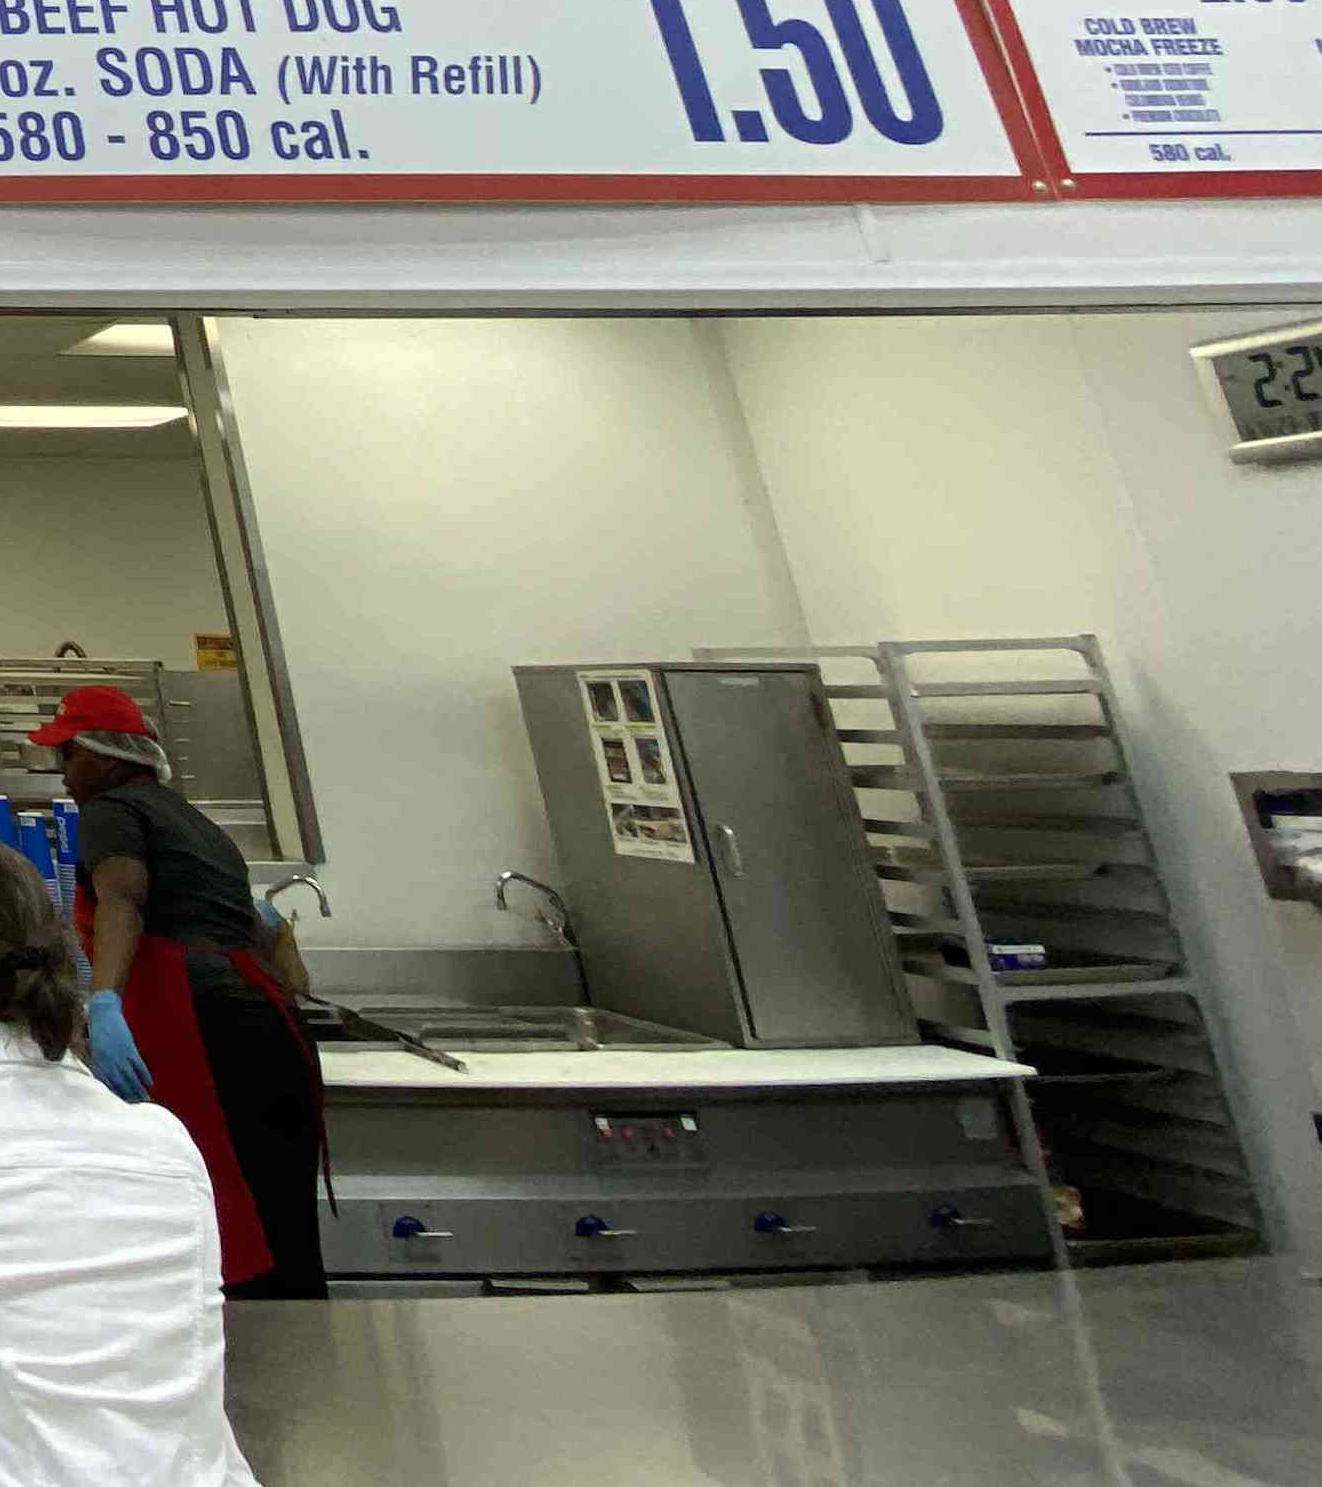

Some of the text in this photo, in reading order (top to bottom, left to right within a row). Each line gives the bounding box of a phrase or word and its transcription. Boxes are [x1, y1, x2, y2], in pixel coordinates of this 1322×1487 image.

[1084, 17, 1198, 35] COLD BREW
[1074, 38, 1224, 56] MOCHA FREEZE
[96, 47, 257, 97] SODA
[277, 55, 393, 106] (With
[410, 54, 542, 105] Refill)
[145, 109, 251, 162] 850
[270, 108, 371, 161] cal.
[1149, 143, 1232, 161] 580 cal.
